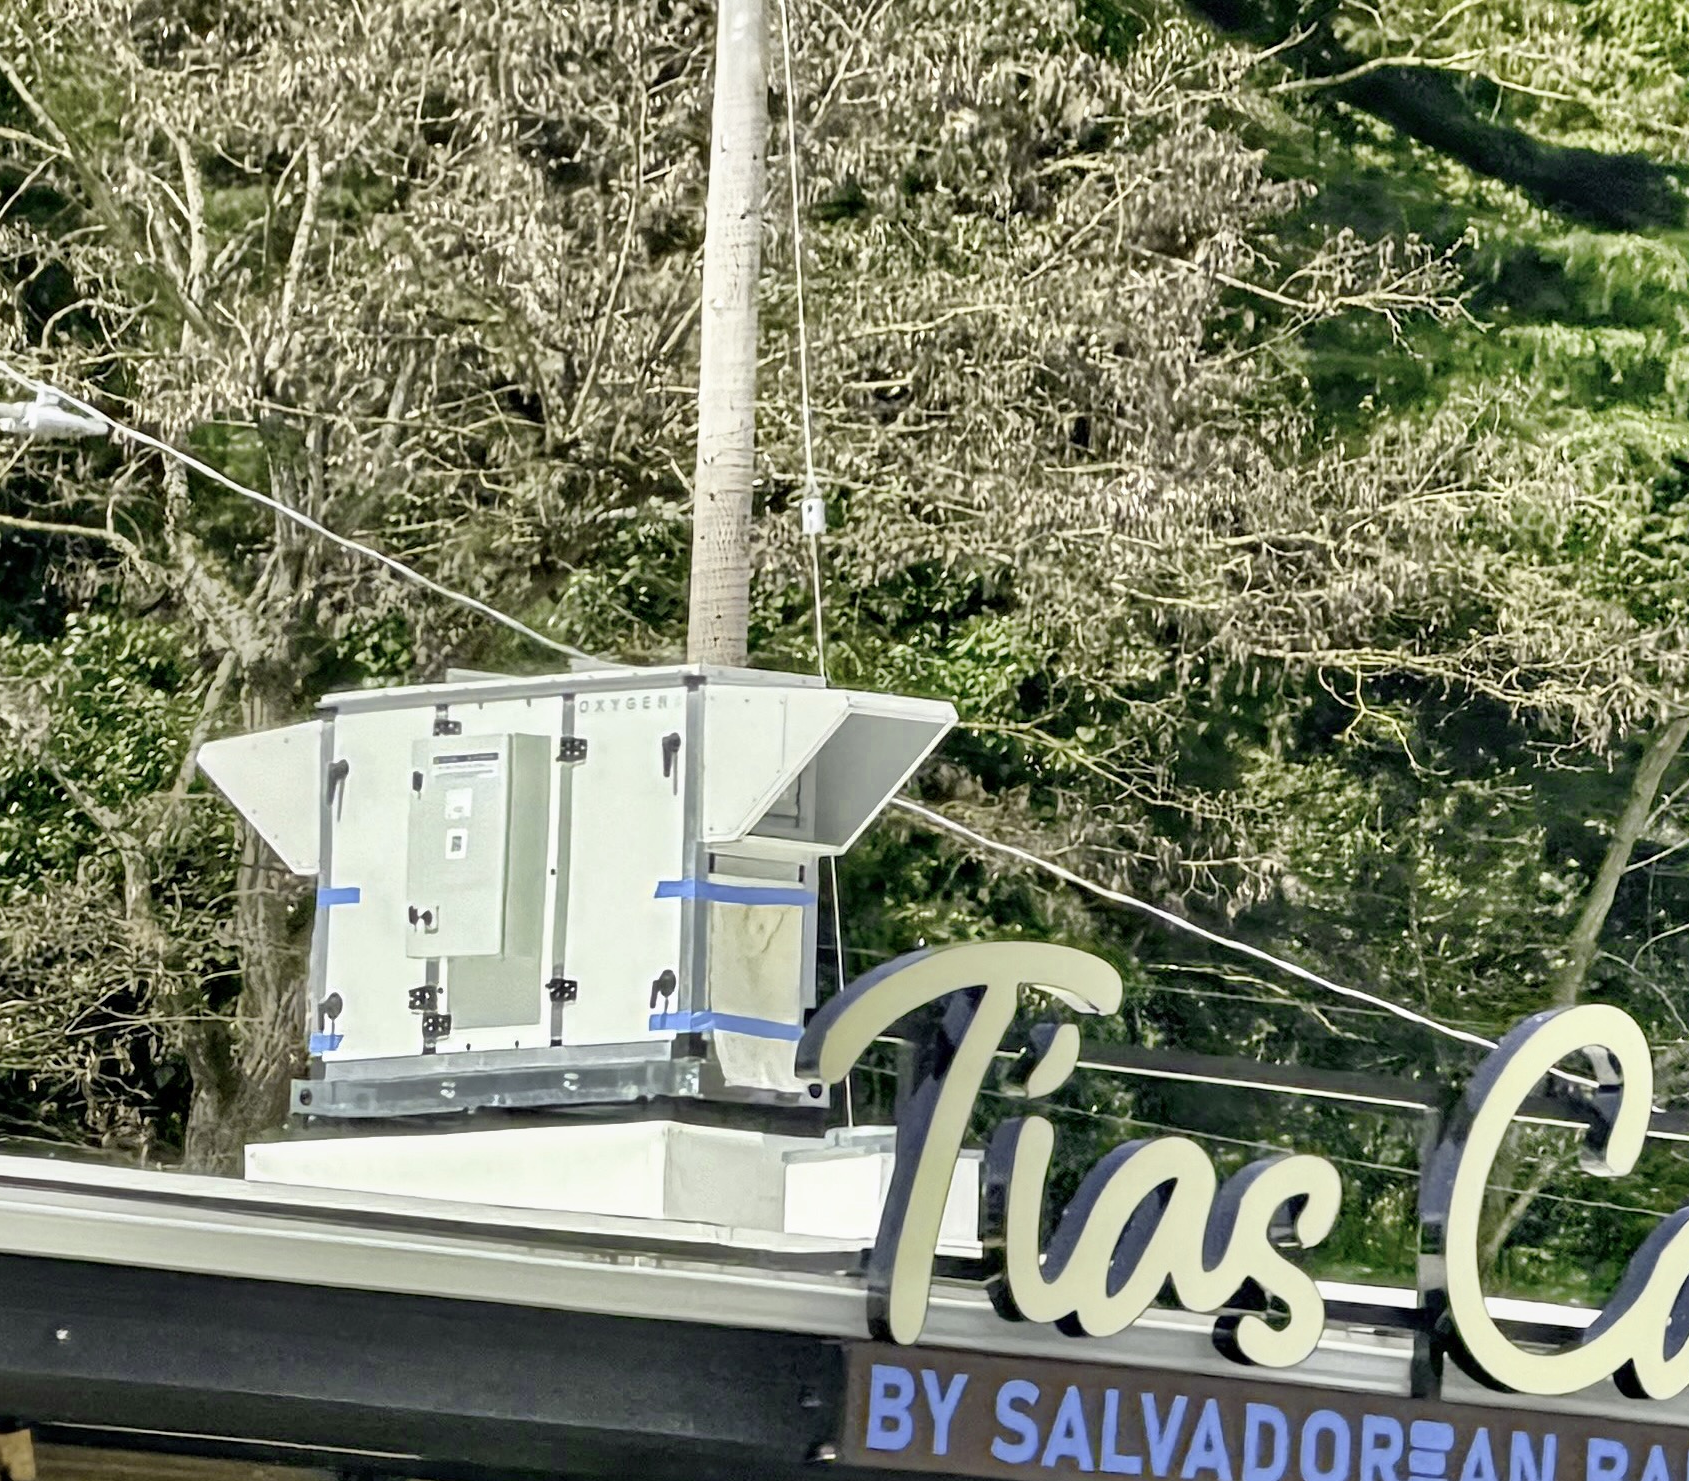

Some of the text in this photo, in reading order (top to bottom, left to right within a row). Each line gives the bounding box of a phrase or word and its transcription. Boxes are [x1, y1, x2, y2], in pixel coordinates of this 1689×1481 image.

[579, 695, 682, 713] OXYGEN
[816, 941, 1342, 1367] Tias
[867, 1364, 969, 1456] BY
